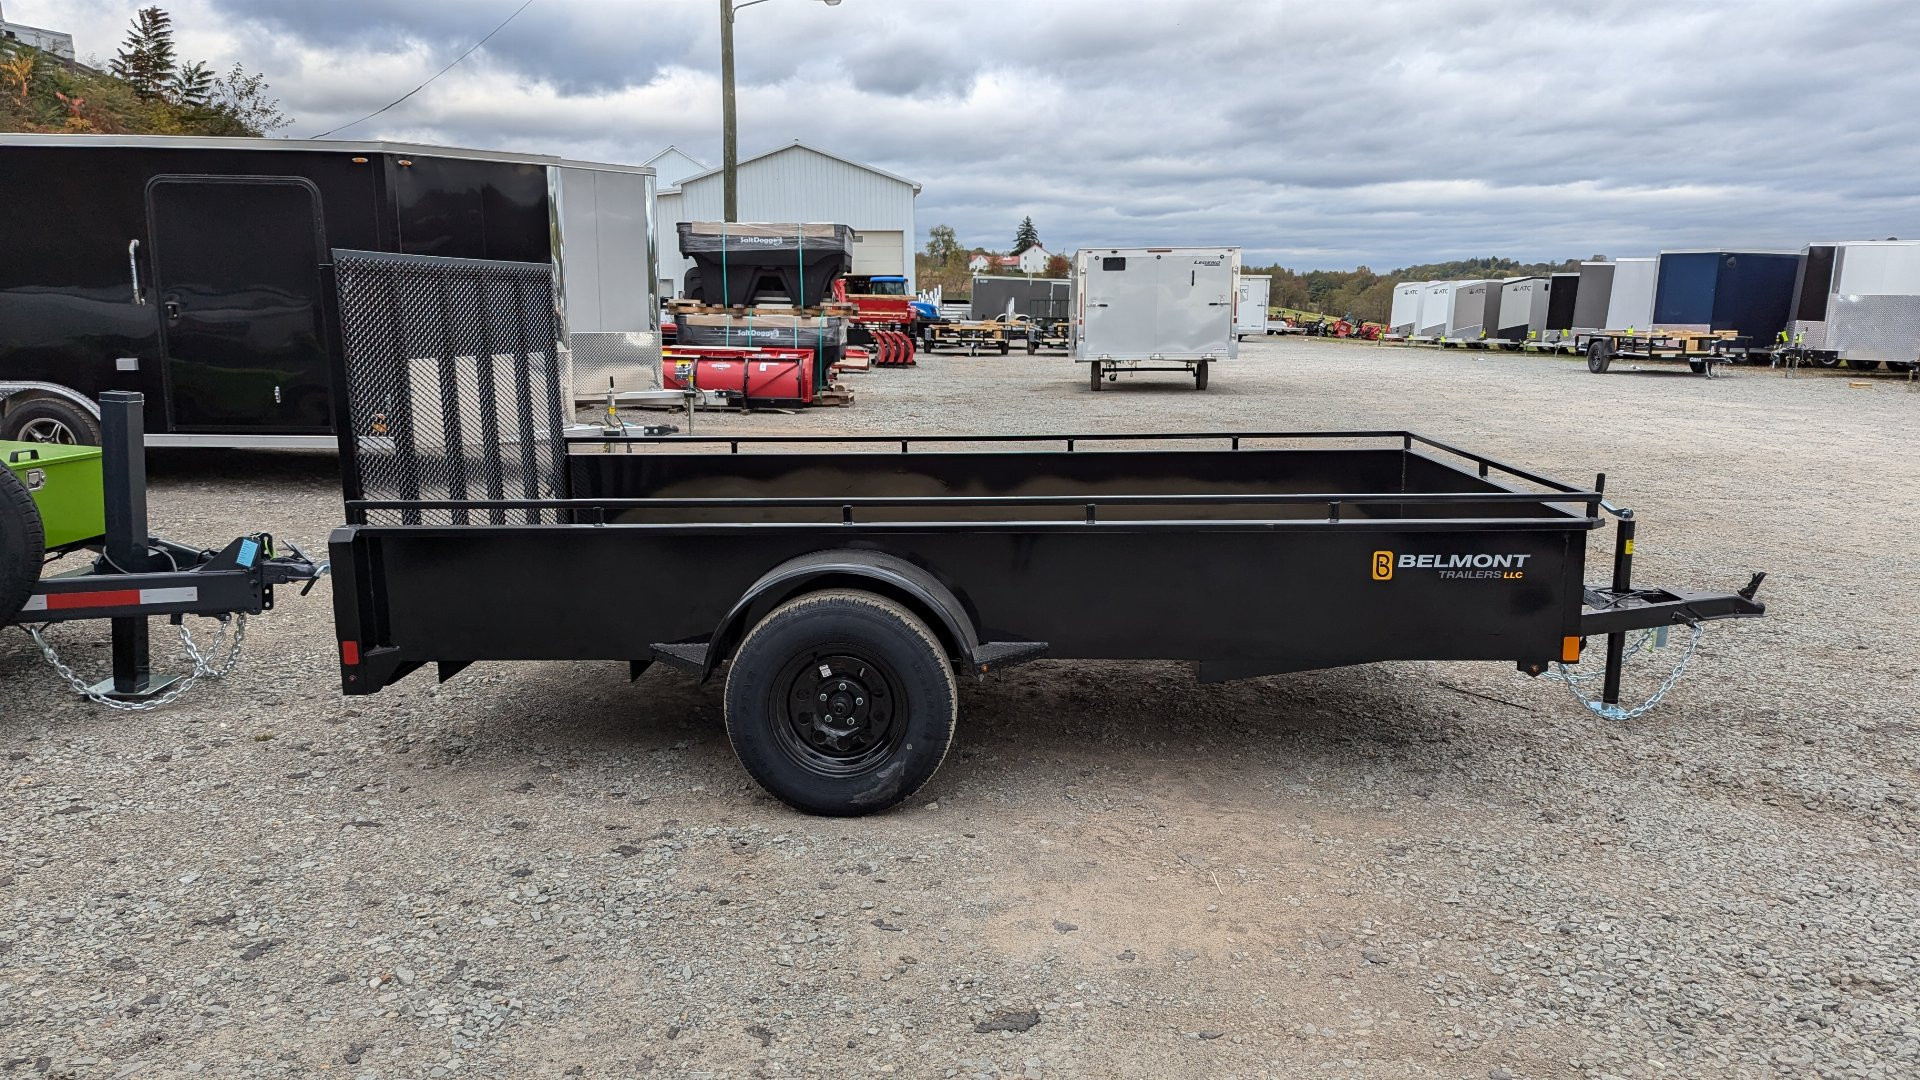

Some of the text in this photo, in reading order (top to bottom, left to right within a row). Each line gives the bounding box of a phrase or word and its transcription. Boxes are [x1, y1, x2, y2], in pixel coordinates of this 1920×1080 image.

[1397, 553, 1531, 568] BELMONT
[1438, 570, 1524, 579] TRAILERS LLC
